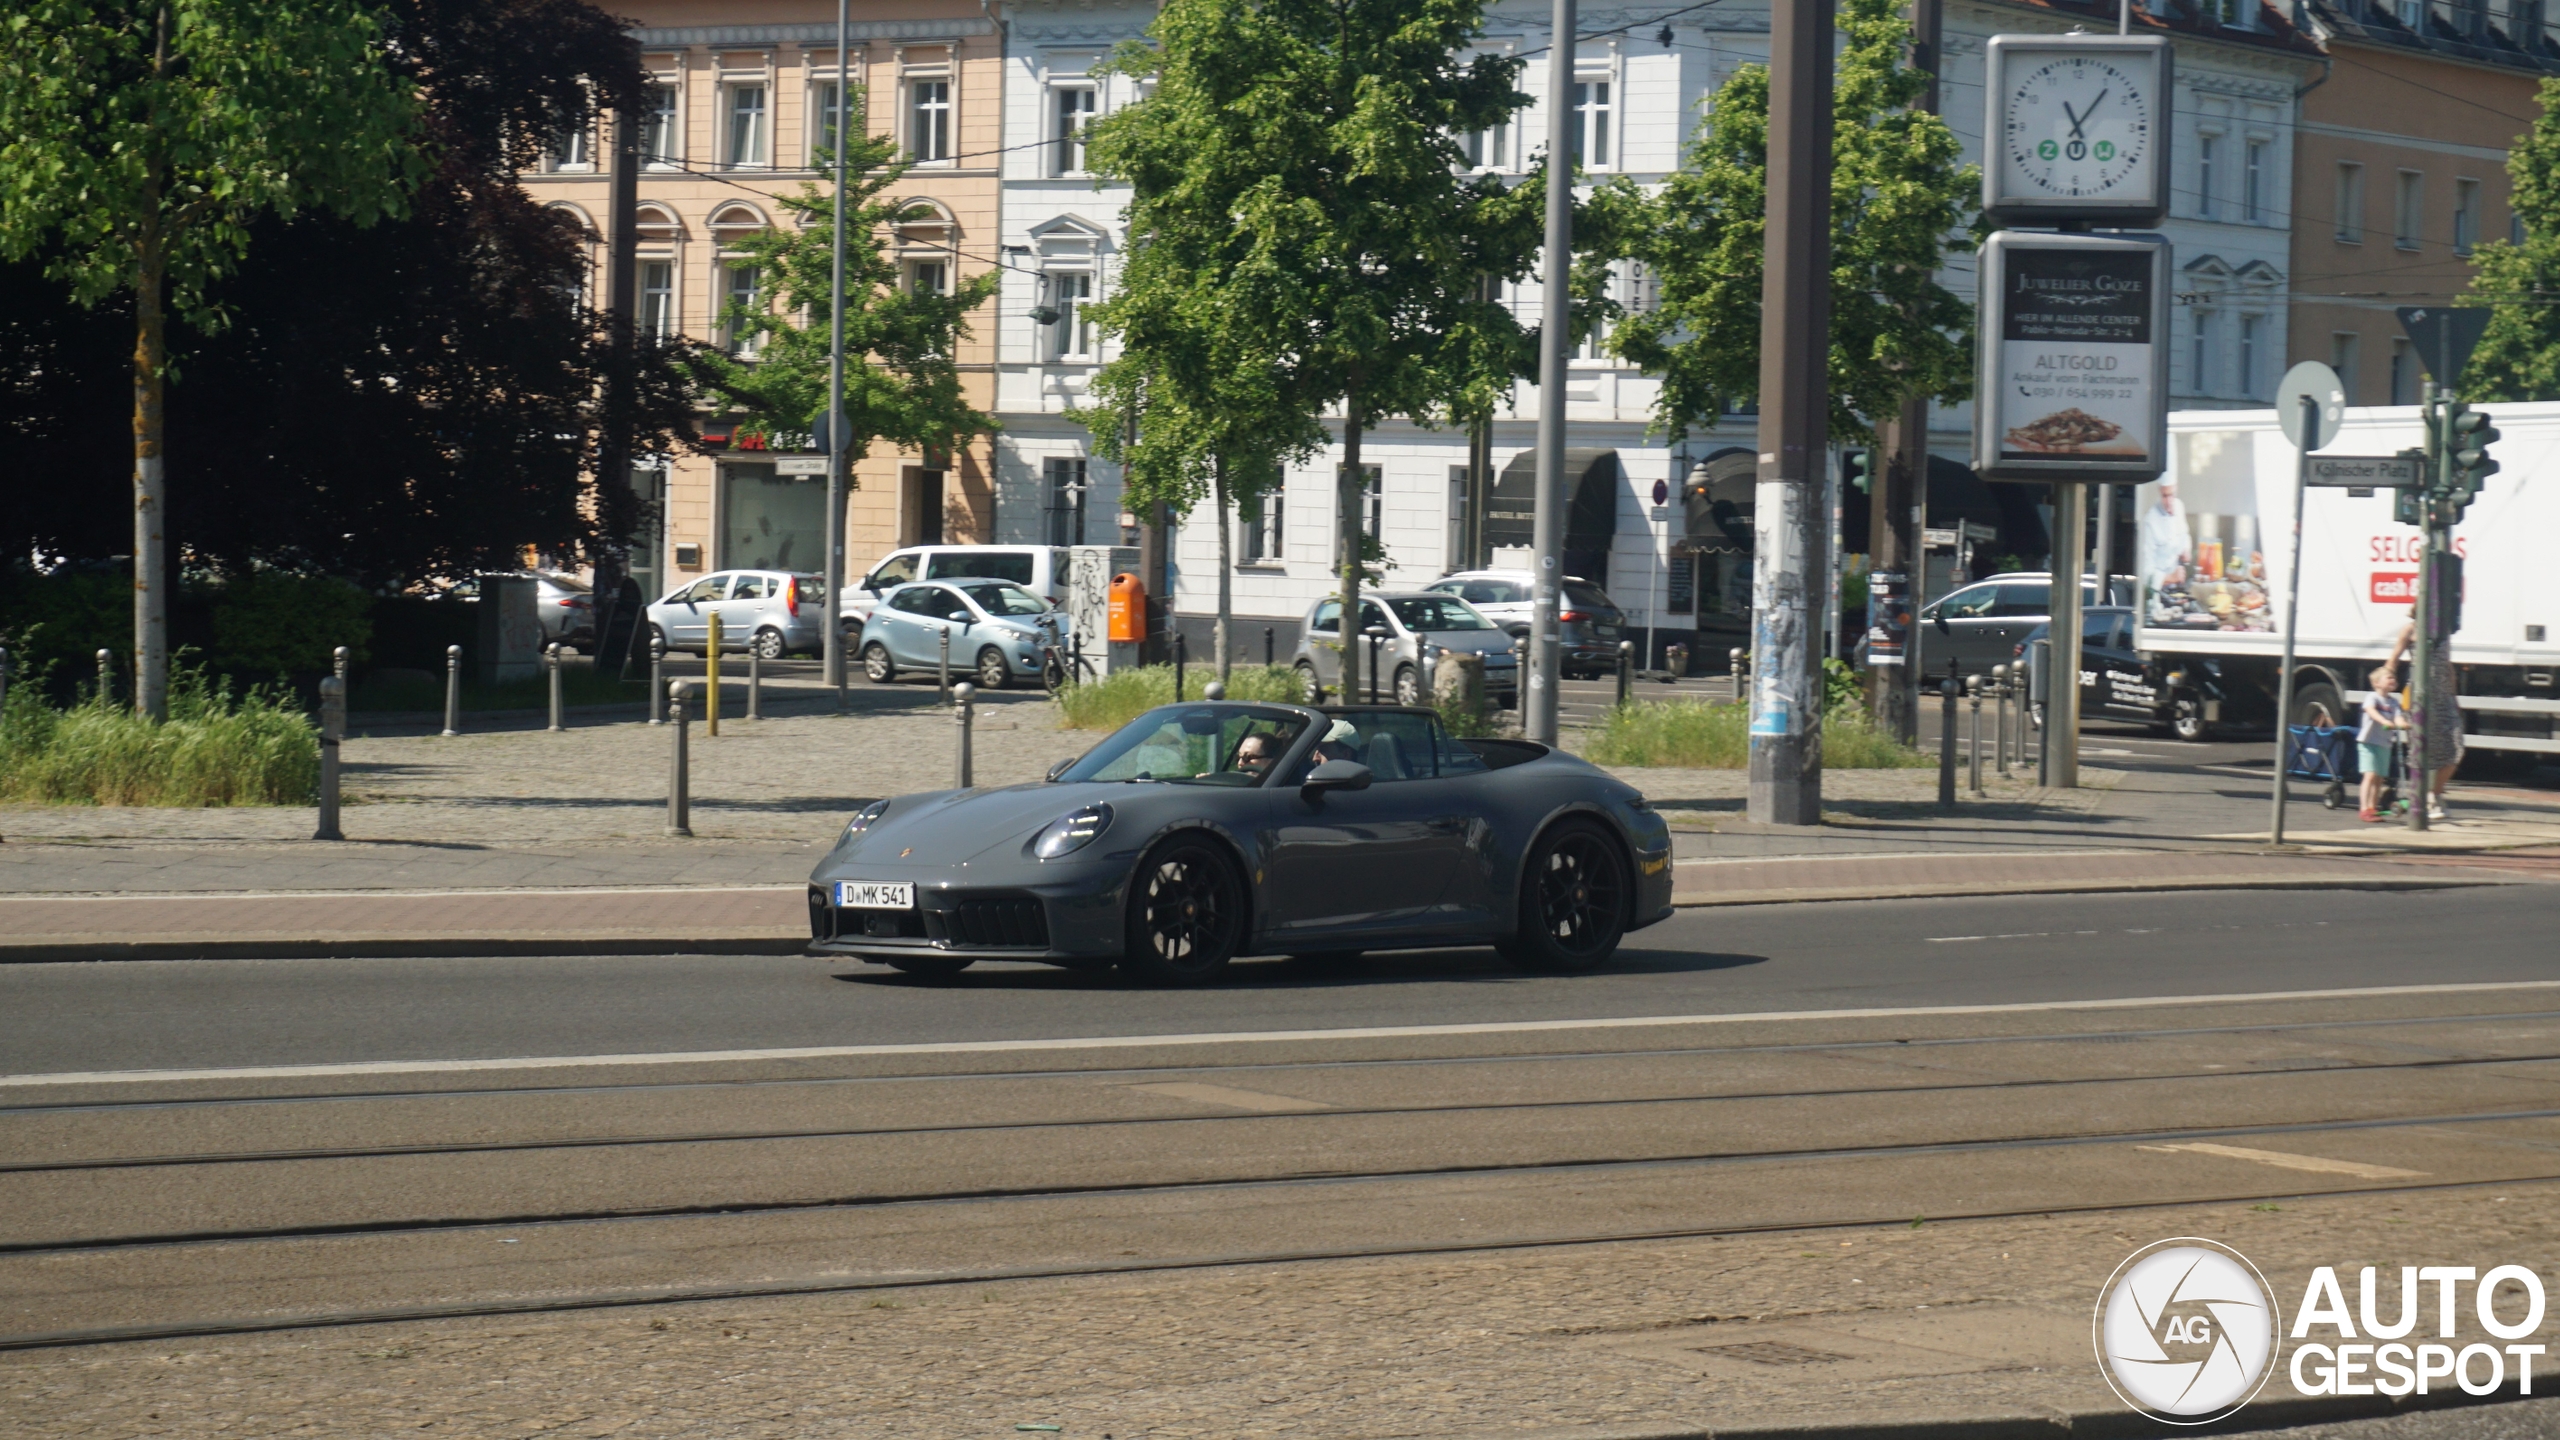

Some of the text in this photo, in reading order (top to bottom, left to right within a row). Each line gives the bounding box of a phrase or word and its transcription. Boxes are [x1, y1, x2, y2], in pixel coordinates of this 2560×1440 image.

[2072, 69, 2084, 79] 12
[2027, 94, 2039, 104] 10
[2121, 95, 2129, 105] 2
[2128, 123, 2136, 133] 3
[2100, 168, 2107, 178] 5
[2071, 175, 2079, 185] 6
[1632, 262, 1642, 311] OTE
[2014, 313, 2141, 325] HIER IM ALLENDE CENTER
[2035, 354, 2118, 370] ALTGOLD
[2013, 372, 2139, 384] Ankauf vom Fachmann
[2033, 386, 2055, 397] 030
[2067, 387, 2087, 399] 654
[2091, 389, 2115, 399] 999
[2118, 389, 2133, 398] 22
[2315, 461, 2410, 477] Köllnischer Platz
[2371, 536, 2467, 562] SELGS
[2374, 577, 2408, 597] cash
[846, 885, 906, 905] D MK 541
